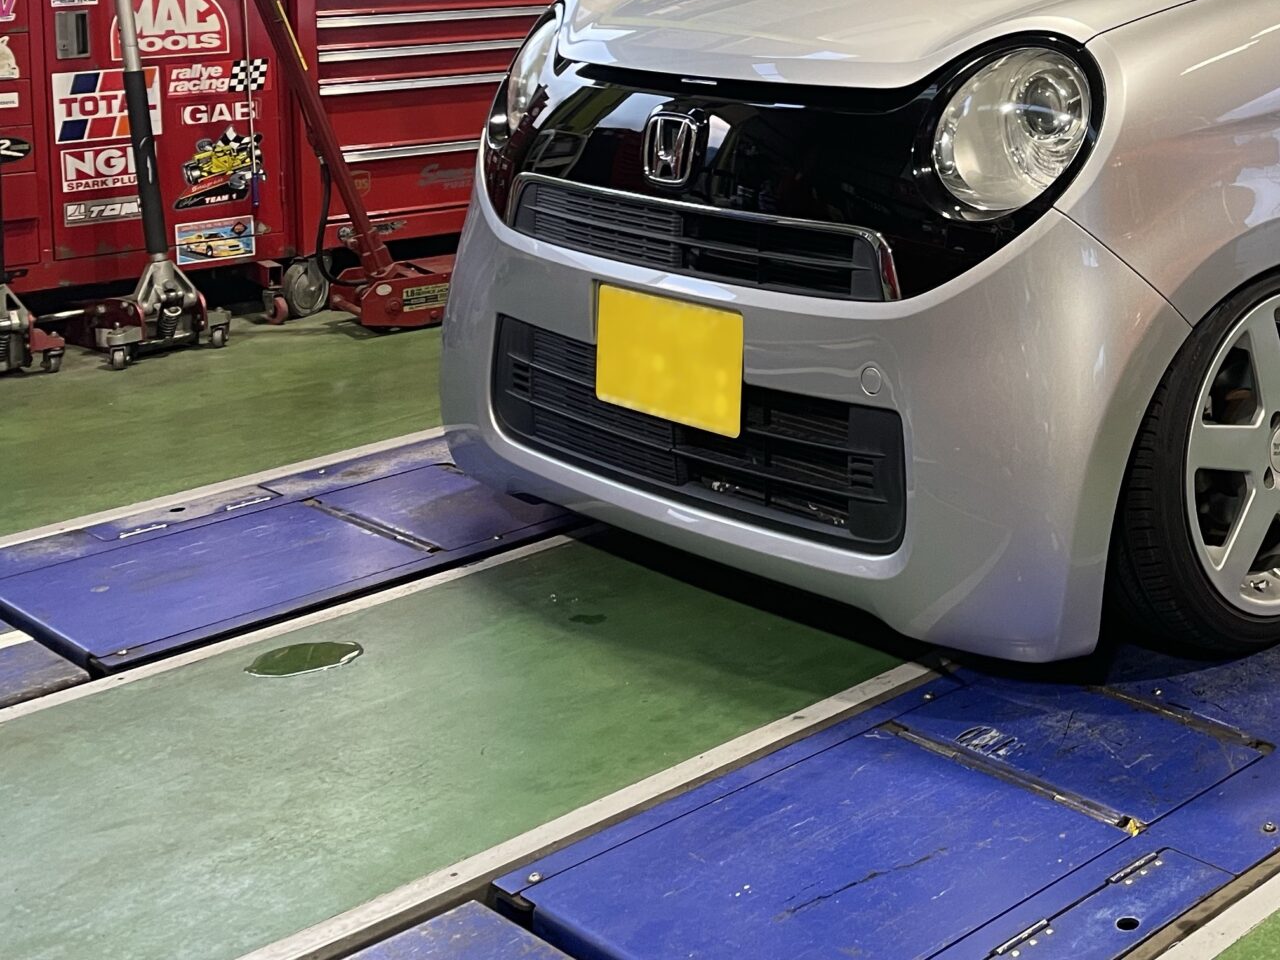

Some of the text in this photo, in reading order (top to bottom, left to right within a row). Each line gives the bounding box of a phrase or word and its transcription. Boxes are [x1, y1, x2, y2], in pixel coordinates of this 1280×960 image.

[136, 33, 221, 52] OOLS
[171, 63, 222, 81] rallye
[169, 76, 230, 93] racing
[183, 102, 256, 125] GAB
[66, 178, 108, 191] SPARK
[205, 194, 229, 204] TEAM
